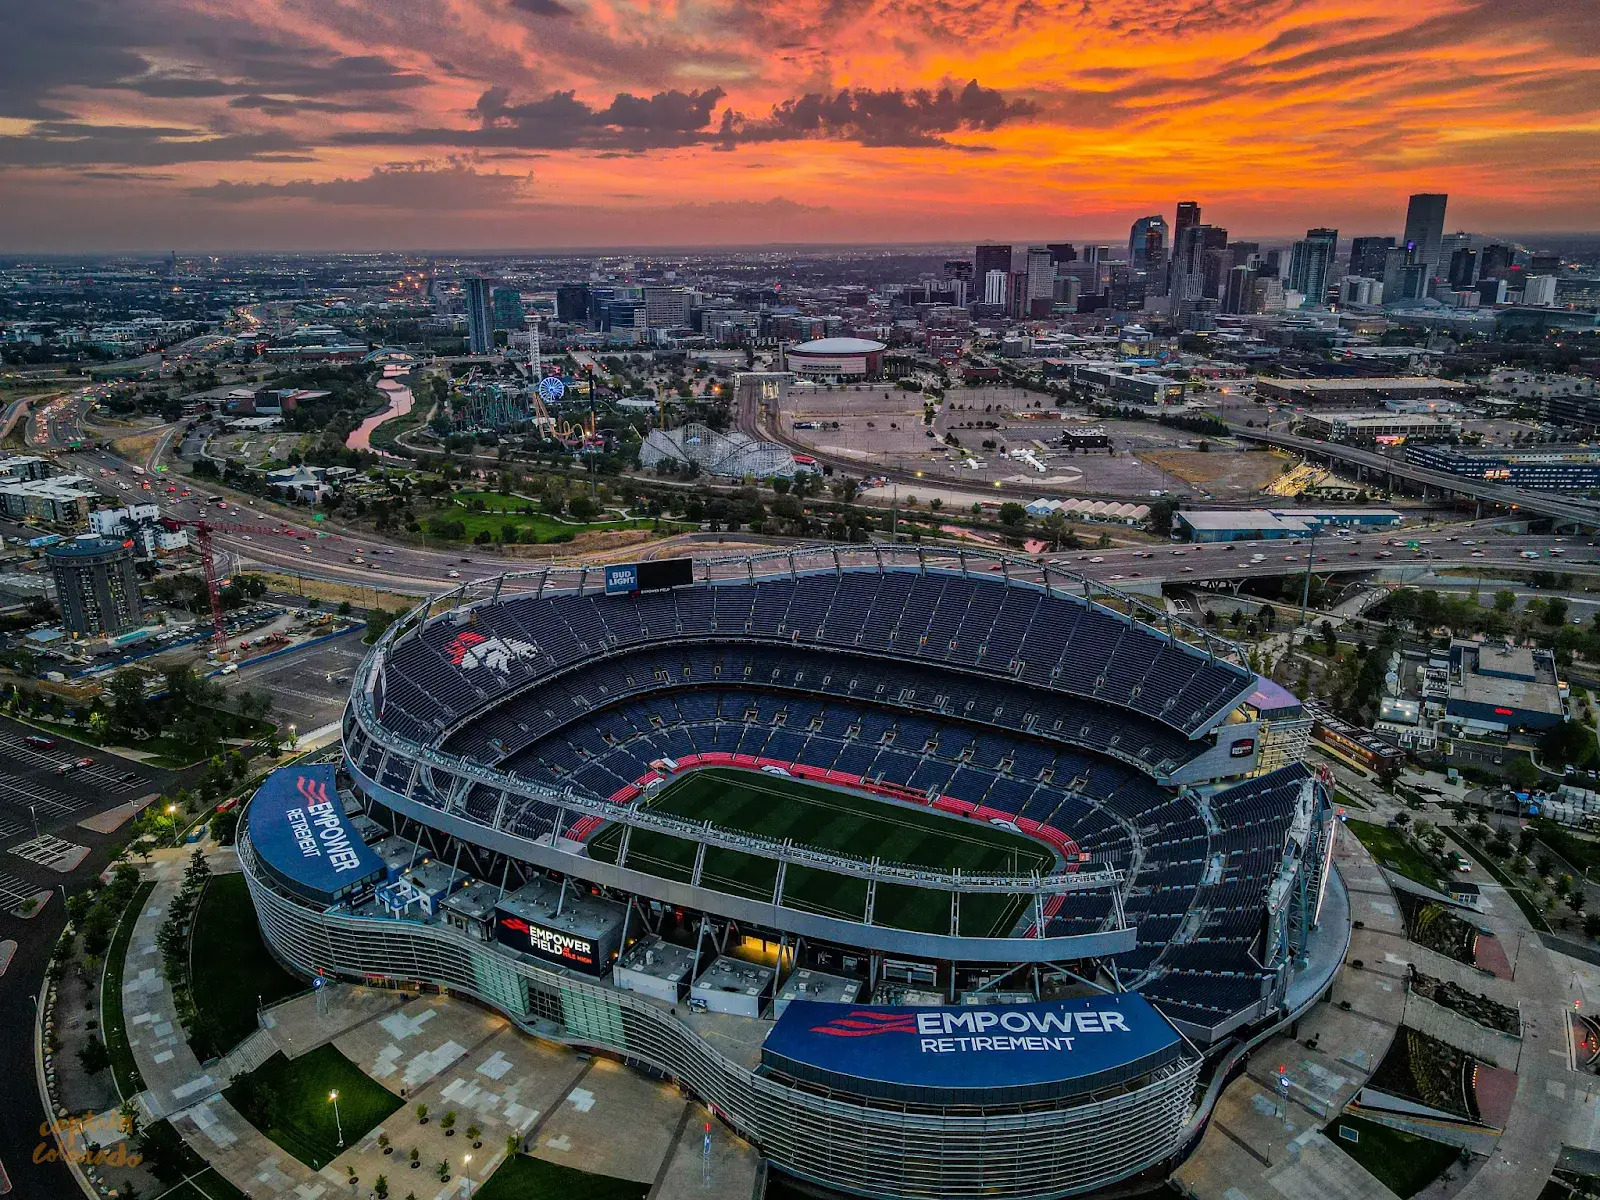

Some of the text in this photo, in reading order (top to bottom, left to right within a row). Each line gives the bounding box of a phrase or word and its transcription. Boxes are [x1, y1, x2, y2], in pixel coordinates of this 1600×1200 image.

[609, 576, 635, 586] LIGHT
[612, 570, 632, 579] BUD
[286, 807, 321, 858] RETIREMENT
[307, 801, 360, 873] EMPOWER
[529, 924, 591, 954] EMPOWER
[530, 937, 563, 955] FIELD
[576, 955, 593, 964] HIGH
[916, 1010, 1131, 1035] EMPOWER
[920, 1036, 1075, 1053] RETIREMENT
